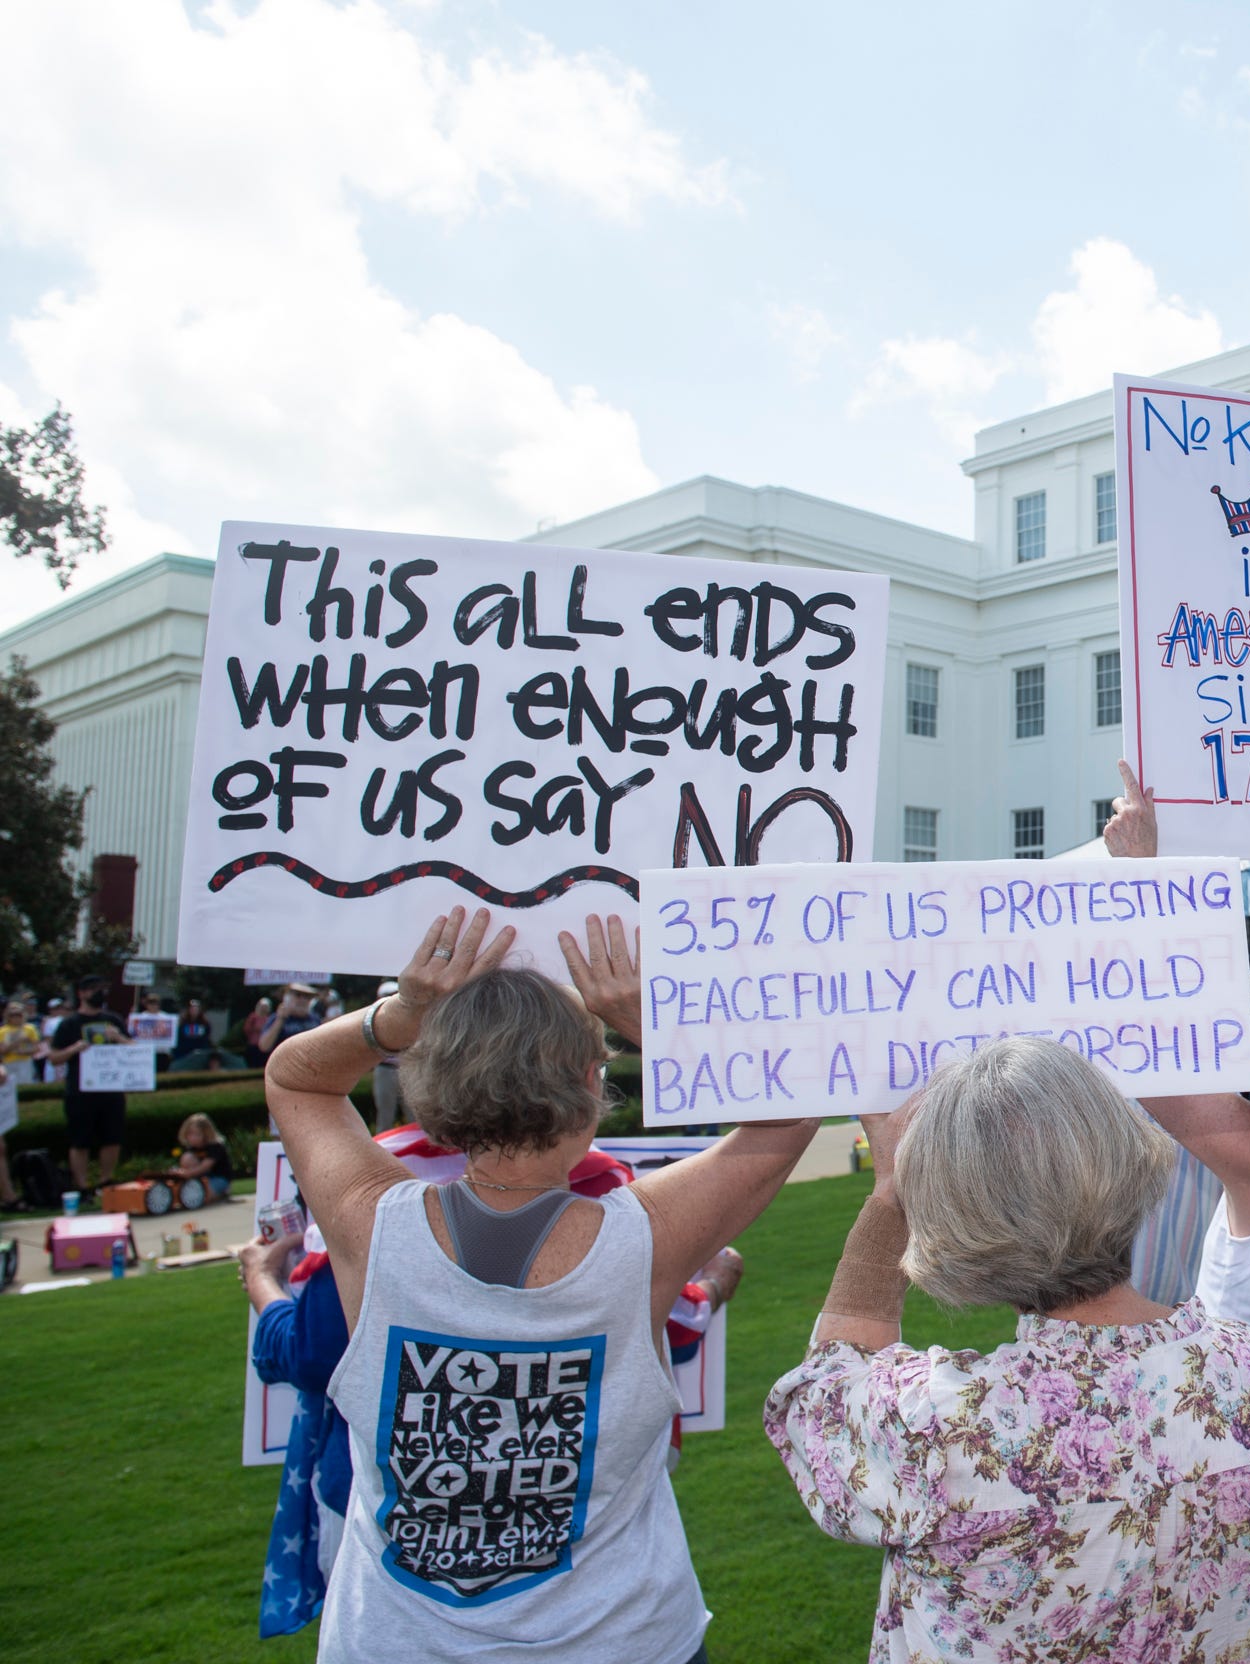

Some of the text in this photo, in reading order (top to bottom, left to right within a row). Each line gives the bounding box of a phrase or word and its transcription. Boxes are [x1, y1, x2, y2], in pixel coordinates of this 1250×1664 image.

[673, 782, 854, 868] NO
[659, 870, 1233, 956] 3.5% OF US PROTESTING
[648, 953, 1206, 1031] PEACEFULLY CAN HOLD
[653, 1046, 796, 1116] BACK
[827, 1041, 860, 1097] A
[403, 1340, 592, 1399] VOTE
[389, 1455, 579, 1500] VOTED
